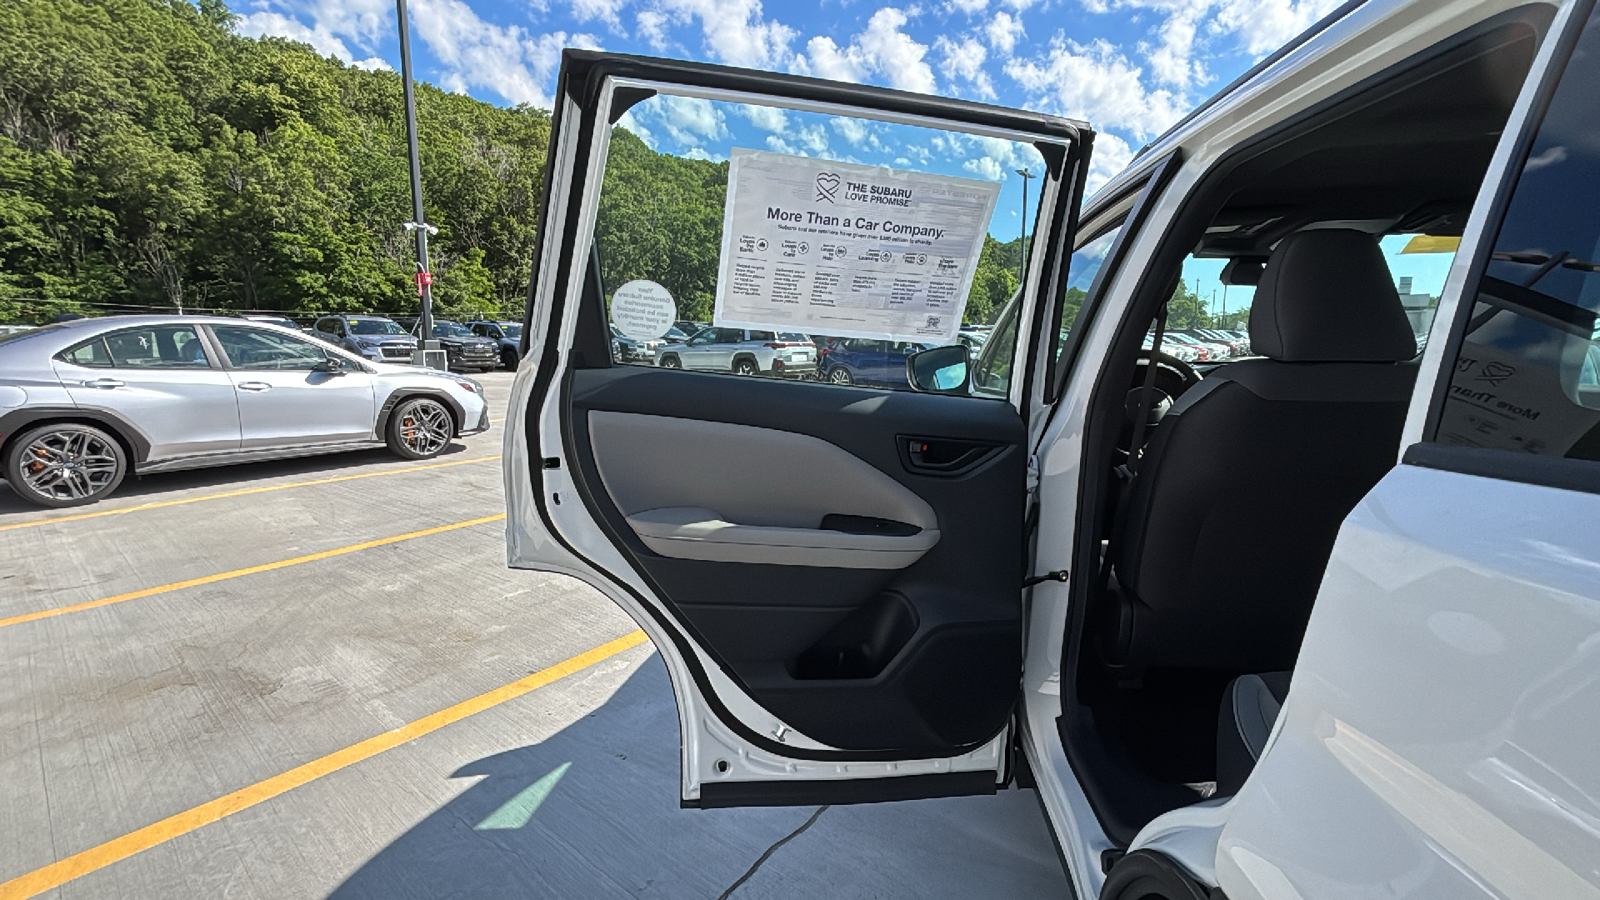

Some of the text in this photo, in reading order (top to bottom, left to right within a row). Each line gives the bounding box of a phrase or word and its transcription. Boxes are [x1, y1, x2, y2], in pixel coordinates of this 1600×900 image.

[846, 181, 912, 199] THE SUBARU
[844, 193, 912, 207] LOVE PROMISE
[767, 207, 945, 239] More Than a Car Company.
